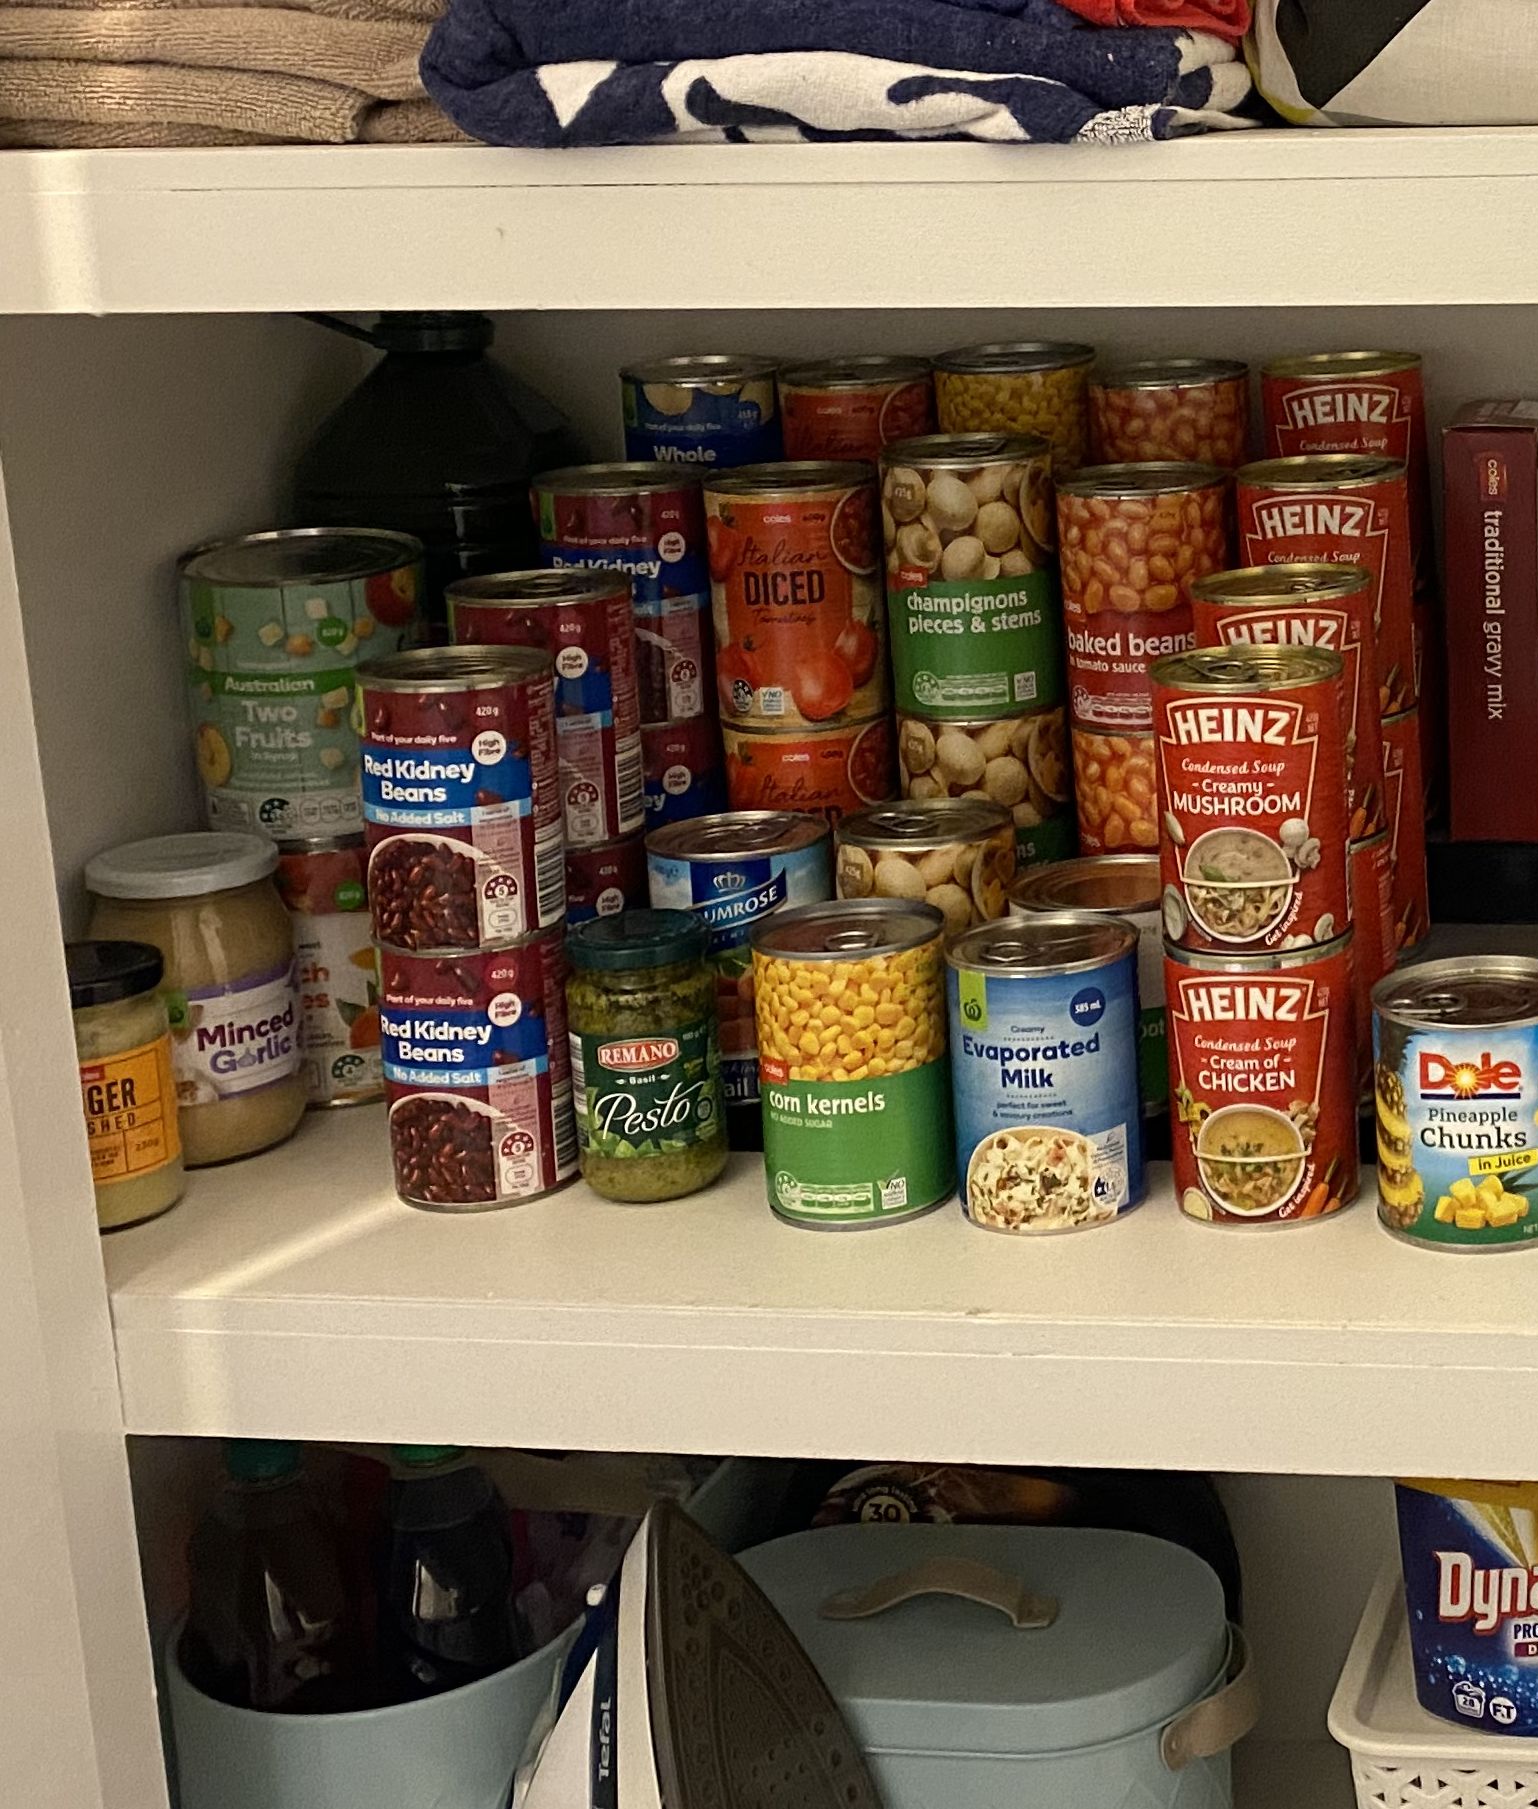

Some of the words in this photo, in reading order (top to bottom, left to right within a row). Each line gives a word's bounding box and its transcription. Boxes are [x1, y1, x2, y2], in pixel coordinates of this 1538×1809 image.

[1293, 393, 1391, 429] HEINZ
[653, 446, 717, 462] Whole
[1300, 438, 1358, 451] Condensed
[1361, 437, 1389, 452] Soup
[1487, 459, 1498, 495] coles
[1261, 504, 1368, 538] HEINZ
[737, 535, 827, 566] Italian
[1268, 551, 1330, 565] Condensed
[1333, 551, 1360, 566] Soup
[1484, 510, 1505, 615] traditional
[743, 570, 825, 606] DICED
[908, 590, 1028, 615] champignons
[909, 613, 965, 635] pieces
[971, 616, 986, 632] &
[992, 607, 1042, 631] stems
[1067, 626, 1122, 656] baked
[1128, 632, 1197, 657] beans
[1482, 620, 1503, 676] gravy
[562, 653, 584, 664] High
[562, 662, 584, 671] Fibre
[1112, 661, 1147, 673] sauce
[225, 675, 315, 693] Australian
[242, 700, 297, 722] Two
[1487, 681, 1504, 720] mix
[236, 726, 312, 749] Fruits
[1175, 708, 1291, 746] HEINZ
[414, 734, 437, 747] daily
[438, 734, 457, 744] five
[478, 738, 500, 749] High
[478, 747, 501, 757] Fibre
[364, 755, 392, 778] Red
[394, 758, 475, 784] Kidney
[1182, 757, 1249, 775] Condensed
[1253, 760, 1285, 776] Soup
[381, 782, 447, 803] Beans
[1202, 779, 1263, 797] Creamy
[1174, 791, 1301, 817] MUSHROOM
[390, 811, 432, 825] Added
[433, 811, 465, 826] Salt
[1265, 925, 1282, 946] Get
[386, 993, 403, 1004] Part
[405, 995, 414, 1004] of
[414, 997, 434, 1007] your
[435, 996, 456, 1007] daily
[457, 996, 473, 1005] five
[494, 1000, 516, 1011] High
[1188, 986, 1302, 1022] HEINZ
[197, 1000, 294, 1052] Minced
[381, 1015, 411, 1039] Red
[414, 1020, 492, 1045] Kidney
[1011, 1025, 1045, 1035] Creamy
[398, 1041, 464, 1063] Beans
[963, 1031, 1100, 1067] Evaporated
[1194, 1034, 1261, 1051] Condensed
[1264, 1037, 1297, 1051] Soup
[600, 1042, 677, 1065] REMANO
[1210, 1055, 1260, 1071] Cream
[1264, 1055, 1279, 1070] of
[393, 1068, 408, 1081] No
[409, 1071, 450, 1083] Added
[452, 1071, 482, 1083] Salt
[629, 1074, 657, 1085] Basil
[1002, 1068, 1054, 1089] Milk
[1198, 1070, 1296, 1093] CHICKEN
[1419, 1052, 1521, 1092] Dole
[594, 1081, 706, 1140] Pesto
[769, 1090, 802, 1113] corn
[806, 1091, 886, 1116] kernels
[804, 1117, 833, 1128] SUGAR
[1428, 1107, 1518, 1127] Pineapple
[1420, 1127, 1527, 1150] Chunks
[1478, 1156, 1492, 1171] in
[1495, 1153, 1532, 1169] Juice
[1278, 1200, 1296, 1219] Get
[1293, 1162, 1316, 1211] inspired
[868, 1502, 902, 1523] 30
[1462, 1696, 1475, 1708] 28
